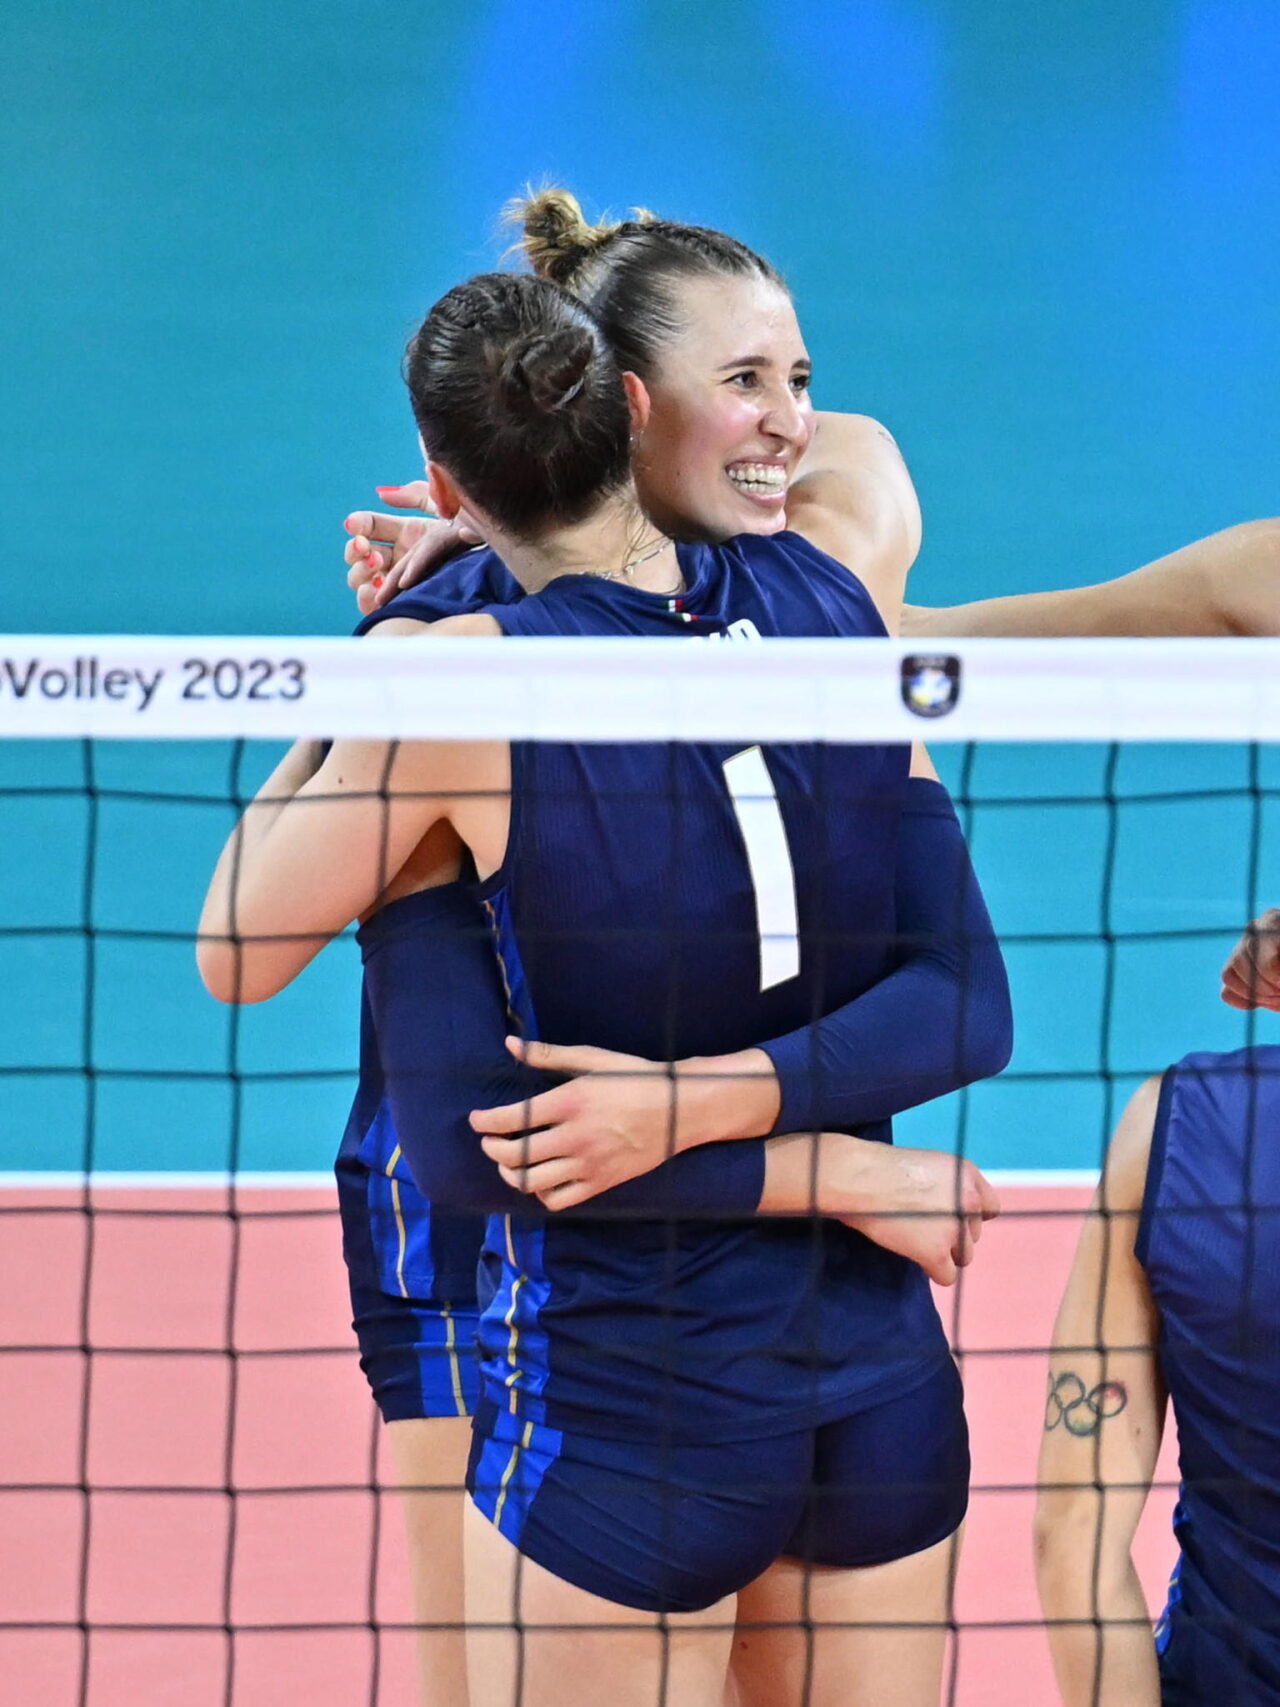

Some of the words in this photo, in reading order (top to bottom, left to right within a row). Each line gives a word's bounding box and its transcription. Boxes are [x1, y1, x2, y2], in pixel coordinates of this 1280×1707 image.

[0, 657, 162, 711] Volley
[182, 659, 305, 700] 2023
[722, 744, 800, 993] 1
